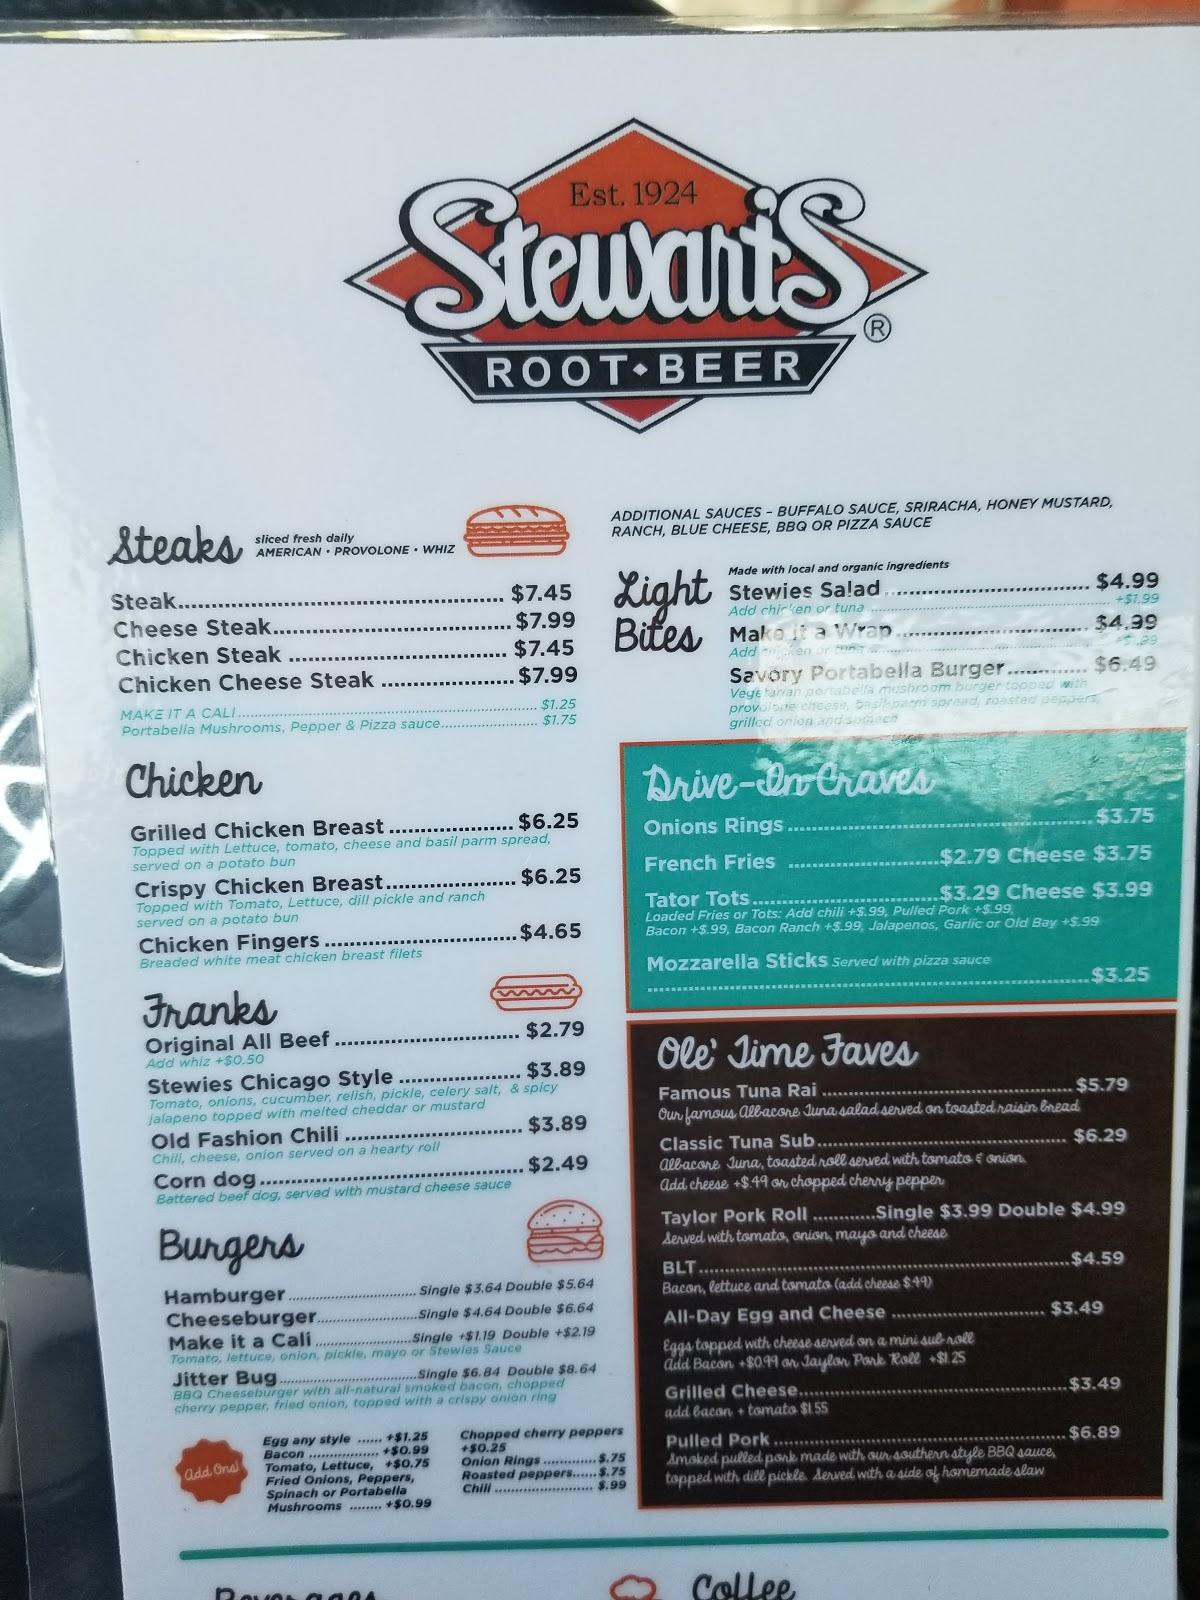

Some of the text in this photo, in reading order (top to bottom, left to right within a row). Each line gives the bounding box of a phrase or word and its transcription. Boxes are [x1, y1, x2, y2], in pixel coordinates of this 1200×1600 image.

[570, 180, 698, 208] Est. 1924
[486, 350, 801, 388] ROOT BEER
[612, 497, 1113, 522] ADDITIONAL SAUCES BUFFALO SAUCE, SRIRACHA, HONEY MUSTARD,
[255, 533, 354, 544] sliced fresh daily
[612, 516, 932, 538] RANCH, BLUE CHEESE, BBQ OR PIZZA SAUCE
[107, 525, 243, 566] Steaks
[257, 544, 455, 557] AMERICAN PROVOLONE WHIZ
[728, 560, 949, 576] Made with local and organic ingredients
[111, 584, 572, 610] Steak $7.45
[614, 570, 712, 625] Light
[730, 572, 1159, 601] Stewies Salad $4.99
[615, 617, 703, 653] Bites
[119, 666, 577, 693] Chicken Cheese Steak $7.99
[730, 655, 1157, 685] Savory Portabella Burger $6.49
[121, 699, 575, 720] MAKE IT A CALI $1.25
[122, 715, 576, 736] Portabella Mushrooms, Pepper & Pizza sauce $1.75
[126, 761, 262, 798] Chicken
[131, 812, 579, 842] Grilled Chicken Breast $6.25
[644, 807, 1154, 837] Onions Rings $3.75
[646, 881, 1152, 908] Tator Tots $3.29 Cheese $3.99
[140, 923, 581, 954] Chicken Fingers $4.65
[140, 948, 422, 968] Breaded white meat chicken breast filets
[648, 952, 1150, 985] Mozzarella Sticks Served with pizza sauce $3.25
[143, 991, 278, 1029] Franks
[145, 1021, 584, 1056] Original All Beef $2.79
[728, 1035, 815, 1068] Time
[822, 1032, 918, 1067] Faves
[146, 1053, 264, 1069] Add whiz +$0.50
[149, 1061, 586, 1095] Stewies Chicago Style $3.89
[659, 1077, 1128, 1101] Famous Tuna Rai $5.79
[154, 1155, 588, 1191] Corn dog $2.49
[662, 1200, 1125, 1228] Taylor Pork Roll Single $3.99 Double $4.99
[160, 1228, 304, 1275] Burgers
[663, 1250, 1125, 1276] BLT $4.59
[165, 1277, 594, 1307] Hamburger Single $3.64 Double $5.64
[664, 1300, 1104, 1326] All-Day Egg and Cheese $3.49
[173, 1362, 597, 1388] Jitter Bug Single $6.84 Double $8.64
[460, 1426, 623, 1441] Chopped cherry peppers
[667, 1424, 1120, 1449] Pulled Pork $6.89
[463, 1479, 626, 1493] Chili $.99
[268, 1498, 431, 1513] Mushrooms +$0.99
